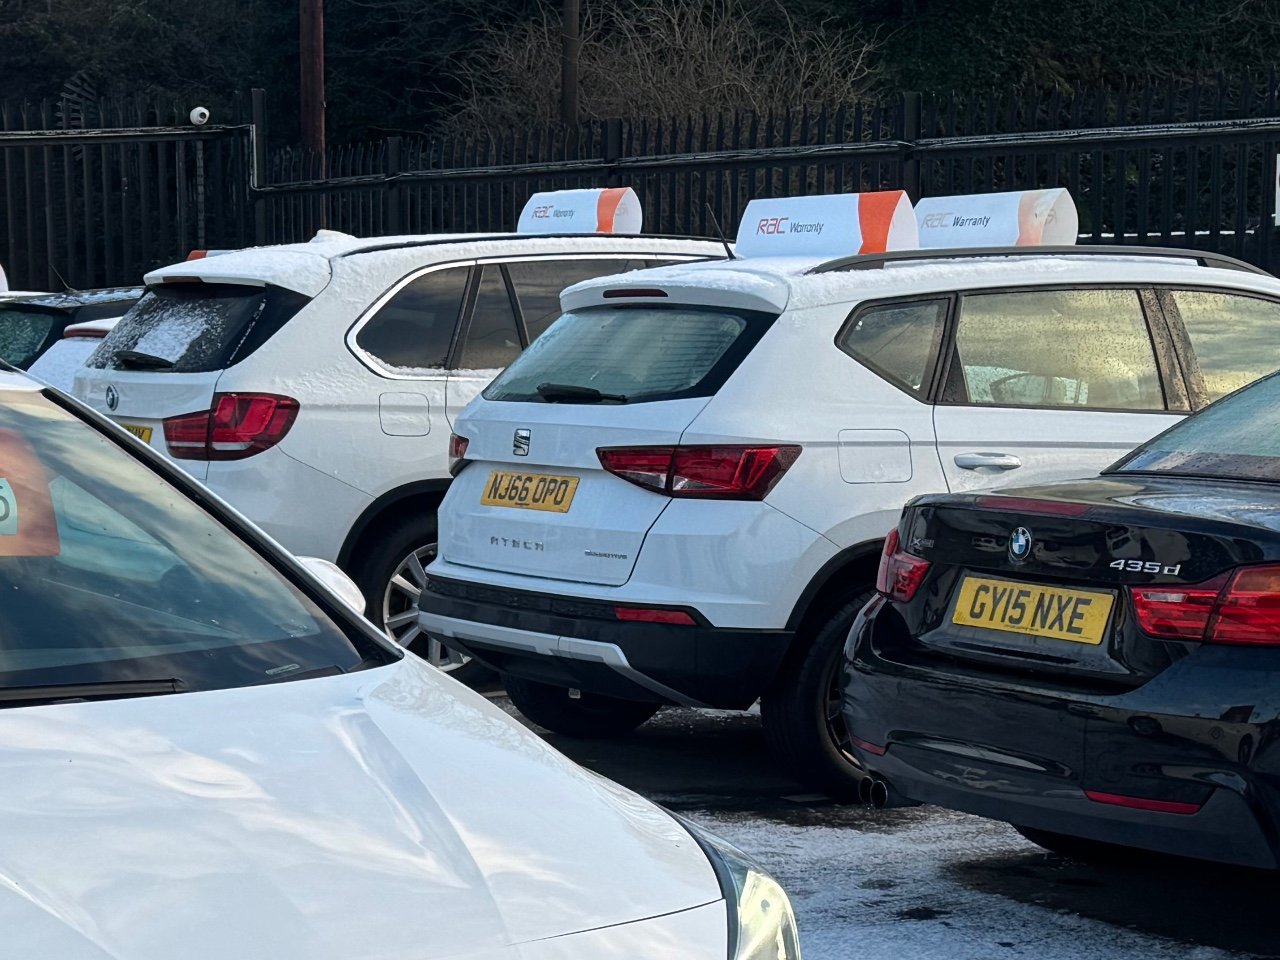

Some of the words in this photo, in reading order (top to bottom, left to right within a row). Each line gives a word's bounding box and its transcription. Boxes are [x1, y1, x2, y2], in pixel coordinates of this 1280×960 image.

[790, 221, 824, 235] Warranty
[952, 215, 990, 228] Warranty
[487, 474, 533, 501] NJ66
[532, 479, 569, 506] OPO
[1109, 558, 1182, 576] 435d
[969, 583, 1032, 626] GY15
[1030, 592, 1092, 635] NXE
